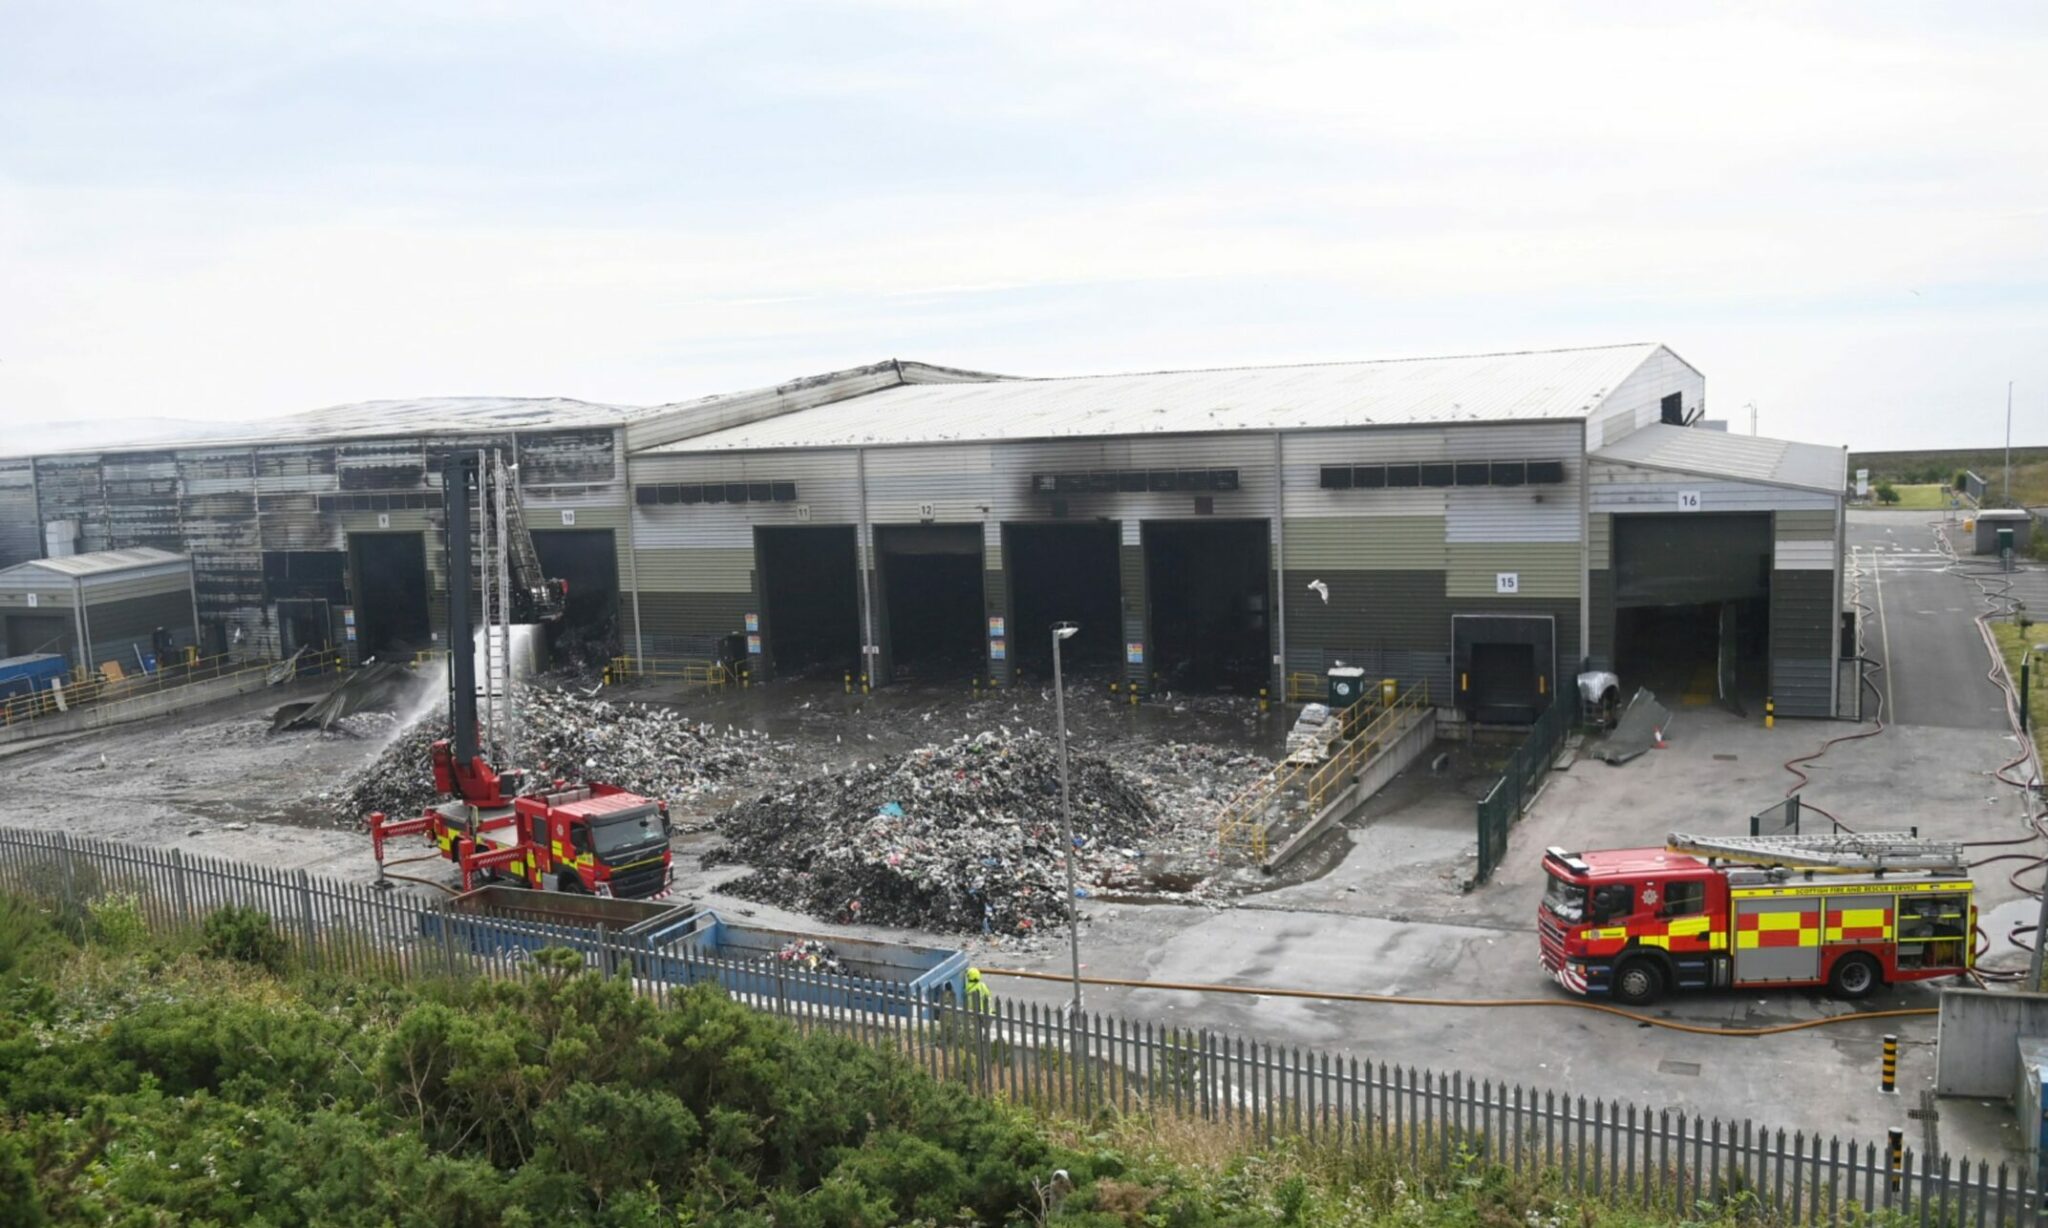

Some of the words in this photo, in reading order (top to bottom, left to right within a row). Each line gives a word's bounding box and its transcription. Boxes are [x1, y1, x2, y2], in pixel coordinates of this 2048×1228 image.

[1682, 495, 1697, 507] 16
[798, 508, 808, 518] 11
[921, 505, 932, 516] 12
[1501, 577, 1514, 588] 15
[1795, 887, 1829, 896] SCOTTISH
[1830, 887, 1845, 895] FIRE
[1846, 886, 1862, 894] AND
[1864, 885, 1889, 893] RESCUE
[1891, 884, 1917, 892] SERVICE
